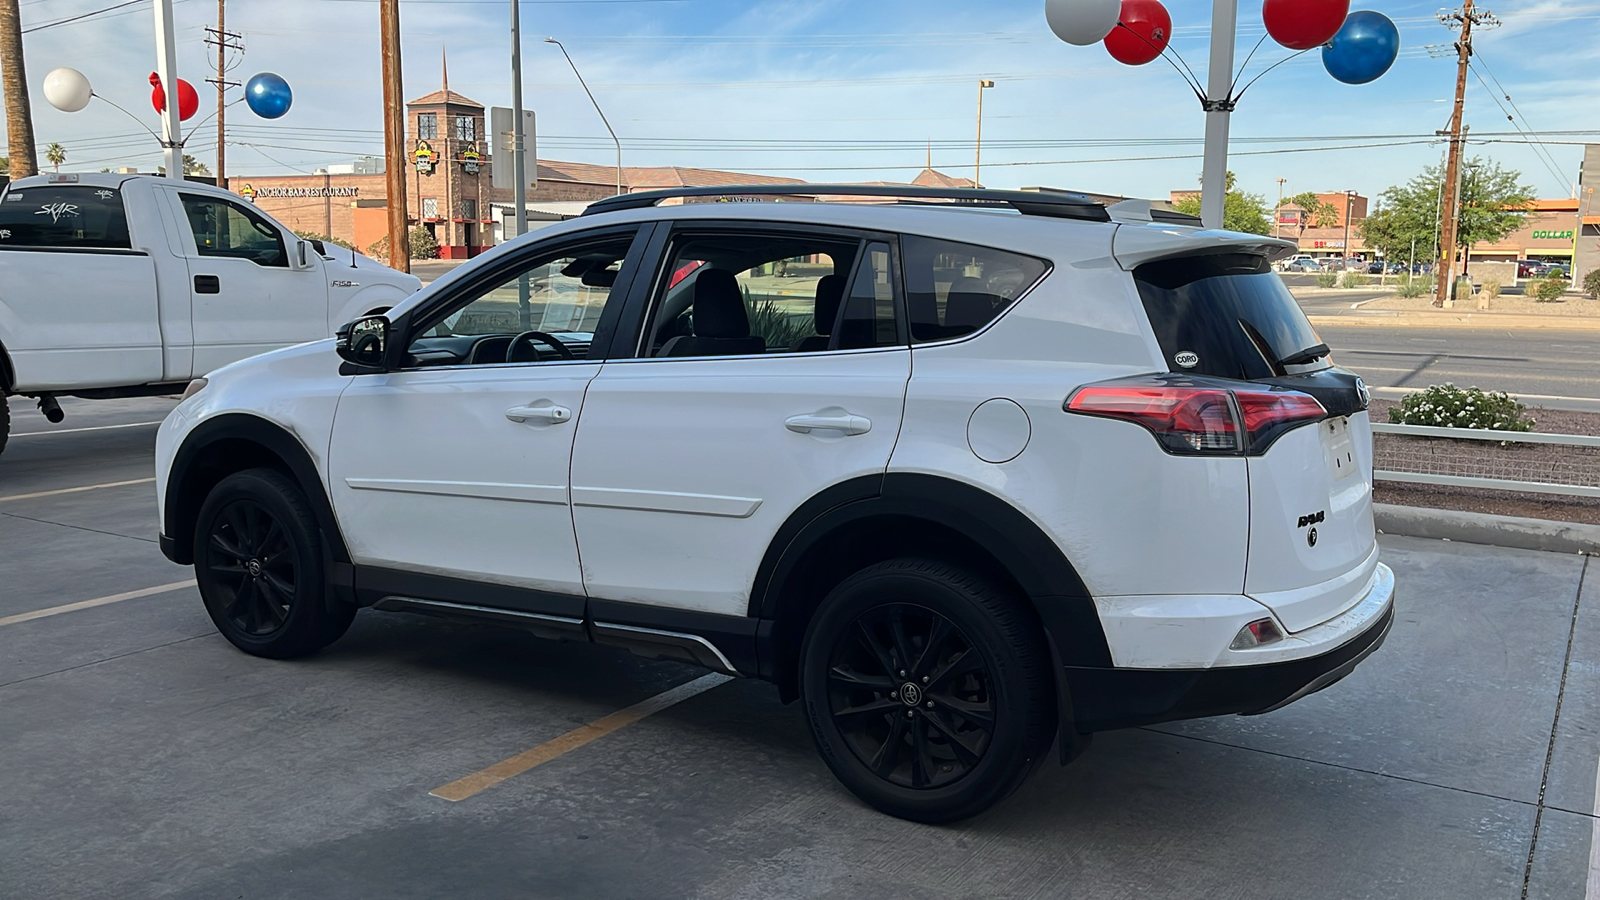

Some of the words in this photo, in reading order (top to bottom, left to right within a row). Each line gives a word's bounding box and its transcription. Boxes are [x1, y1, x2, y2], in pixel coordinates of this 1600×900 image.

[256, 187, 287, 197] ANCHOR
[289, 187, 305, 197] BAR
[305, 186, 358, 197] RESTAURANT
[34, 202, 79, 224] SKAR
[1532, 230, 1573, 239] DOLLAR
